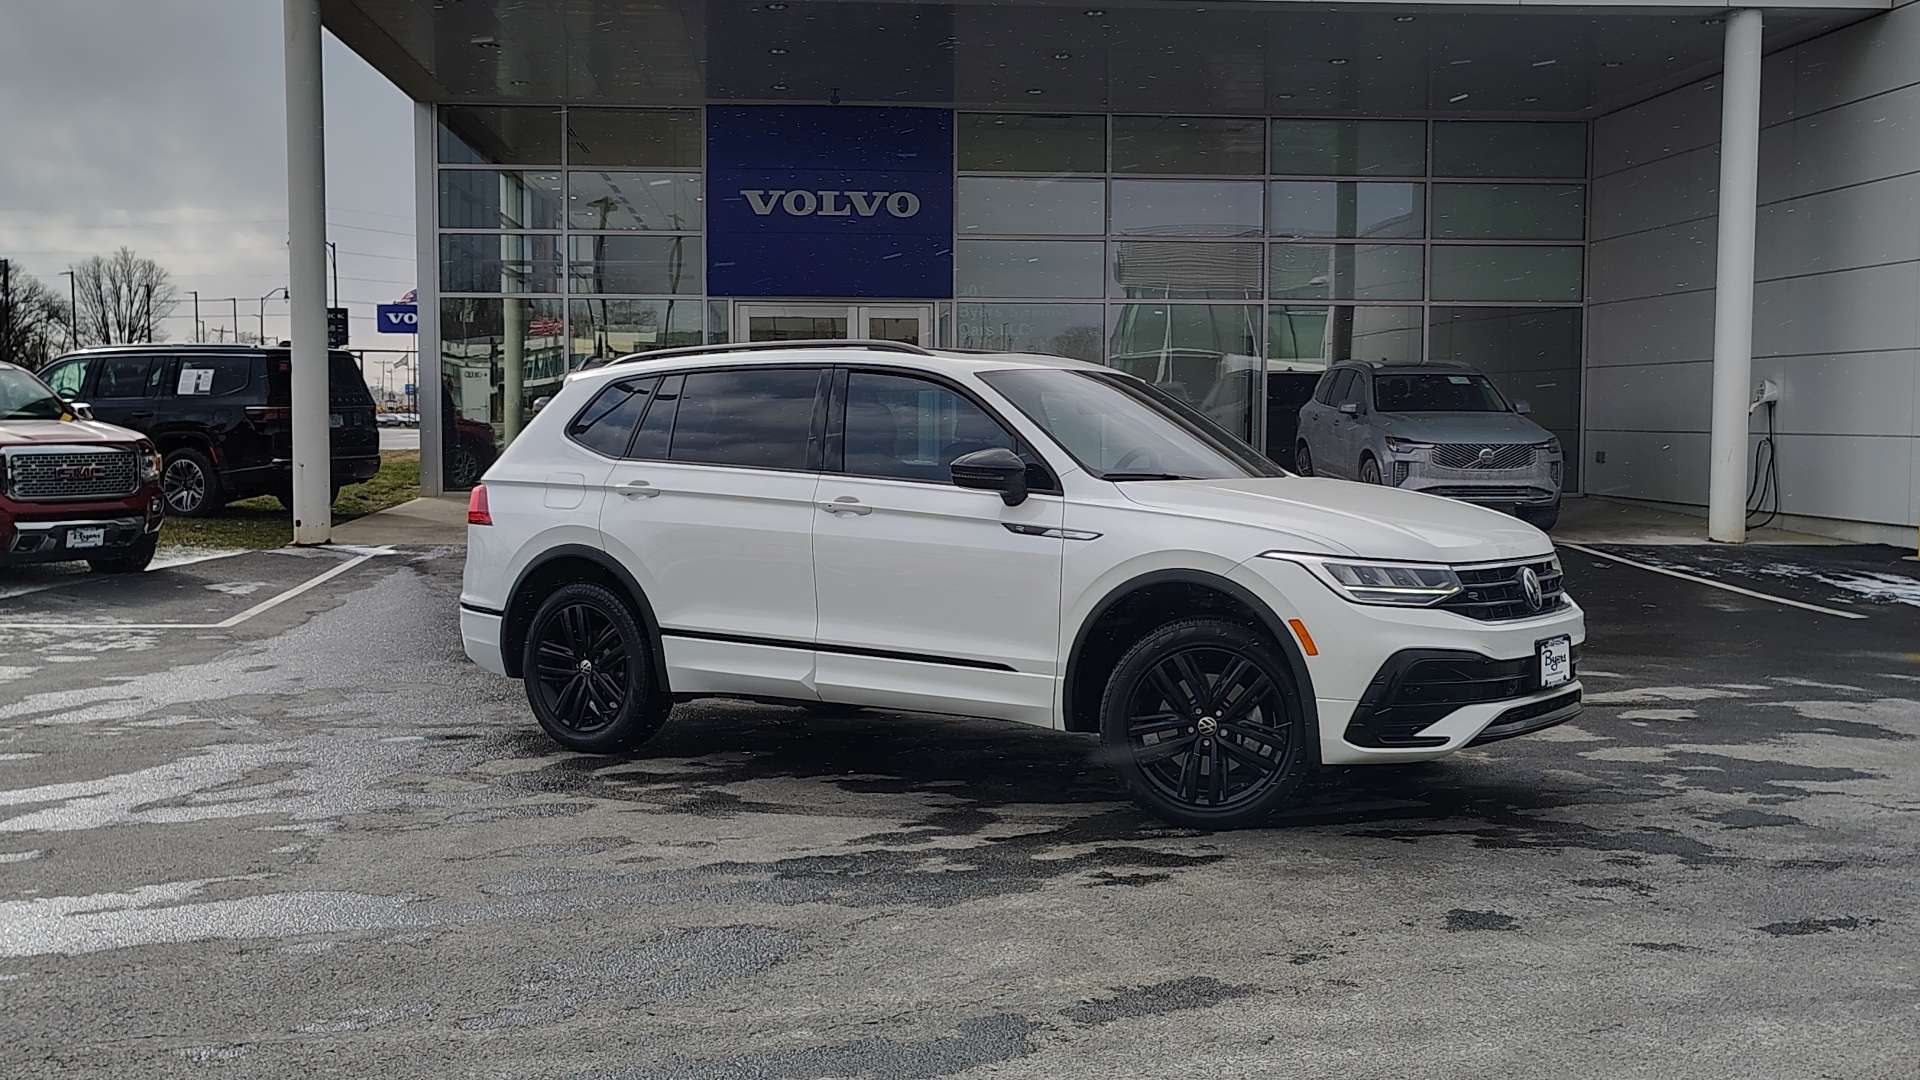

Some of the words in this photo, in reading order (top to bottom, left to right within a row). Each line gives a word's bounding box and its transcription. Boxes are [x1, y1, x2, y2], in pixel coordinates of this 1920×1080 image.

[739, 189, 921, 218] VOLVO
[958, 306, 1003, 321] Byers
[55, 465, 106, 479] GMC
[1541, 649, 1567, 671] Byers
